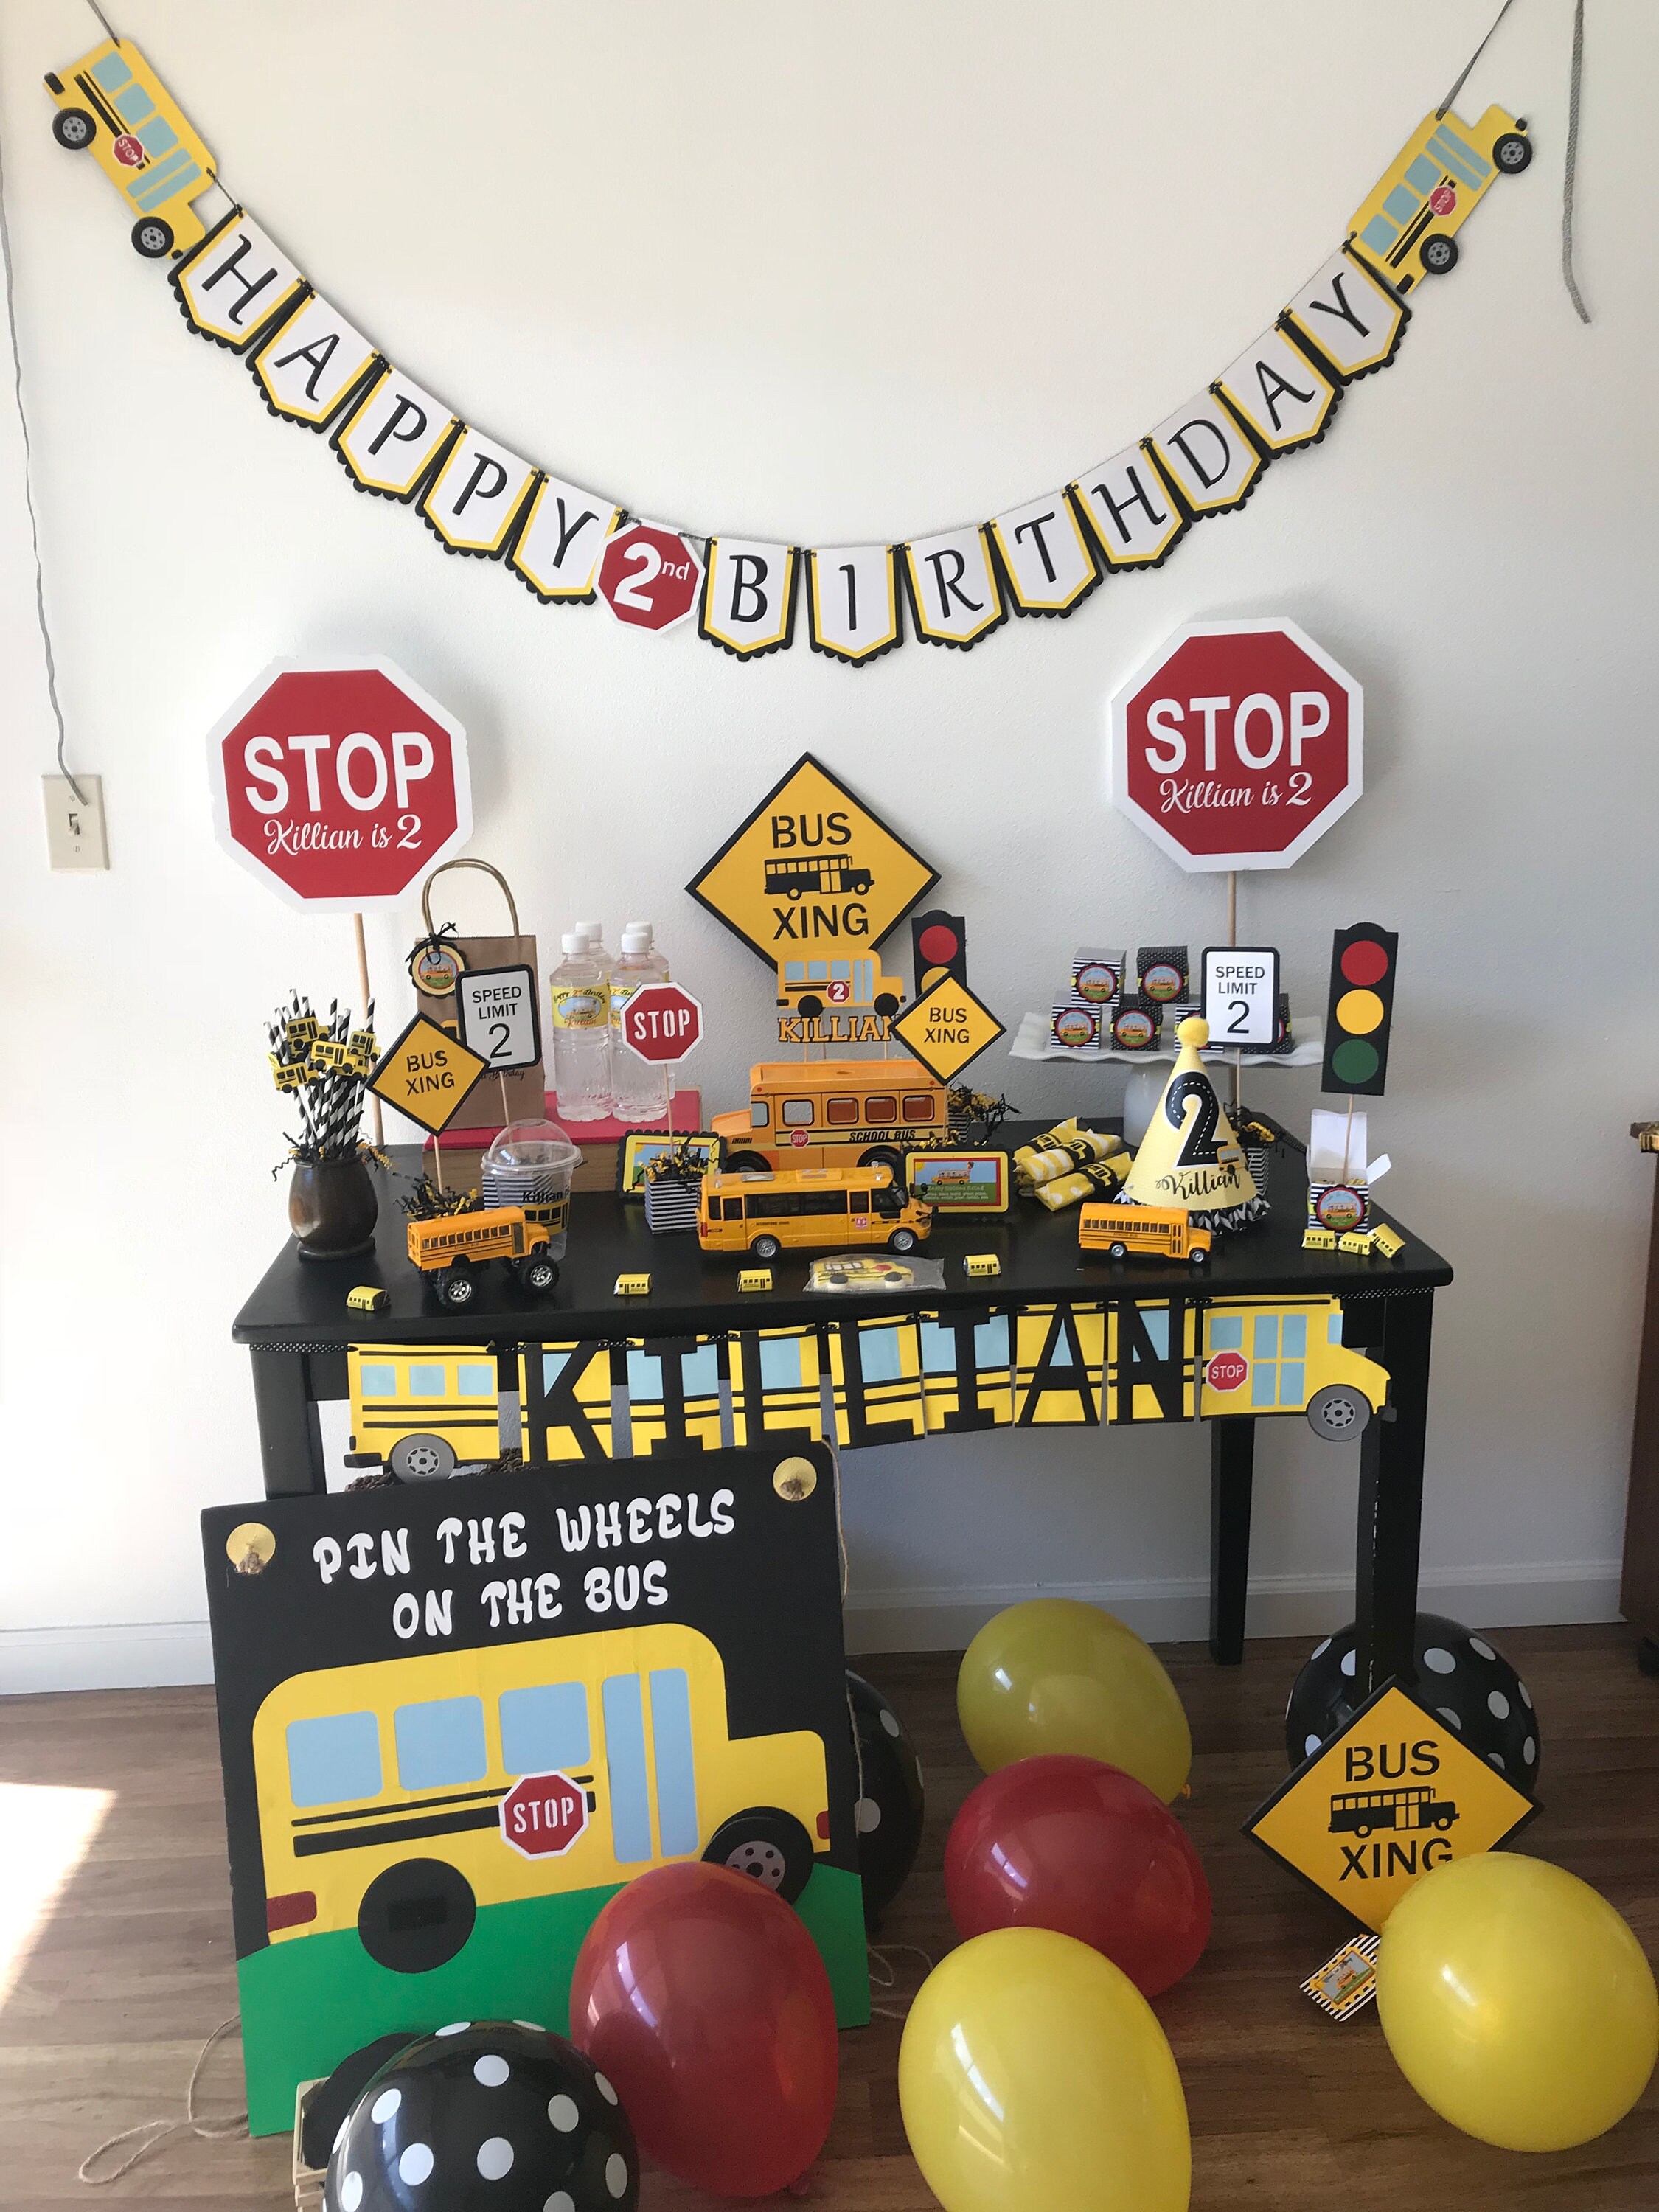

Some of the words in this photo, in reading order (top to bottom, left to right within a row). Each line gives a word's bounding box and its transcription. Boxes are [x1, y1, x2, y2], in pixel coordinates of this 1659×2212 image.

[118, 139, 139, 161] STOP
[201, 234, 599, 568] HAPPY
[613, 541, 688, 613] 2nd
[730, 272, 1370, 631] BIRTHDAY
[1145, 690, 1330, 774] STOP
[244, 731, 434, 815] STOP
[1158, 778, 1255, 814] Killian
[1261, 781, 1283, 807] is
[1286, 772, 1312, 806] 2
[263, 818, 364, 855] Killian
[371, 823, 393, 849] is
[396, 814, 422, 849] 2
[771, 812, 852, 849] BUS
[773, 903, 869, 940] XING
[1215, 966, 1265, 978] SPEED
[472, 986, 522, 1004] SPEED
[832, 983, 845, 1000] 2
[1218, 982, 1258, 995] LIMIT
[479, 1003, 518, 1020] LIMIT
[633, 1009, 690, 1040] STOP
[929, 1007, 967, 1023] BUS
[1227, 1000, 1250, 1034] 2
[488, 1023, 512, 1059] 2
[924, 1028, 970, 1043] XING
[406, 1050, 448, 1072] BUS
[405, 1071, 456, 1096] XING
[1165, 1071, 1228, 1167] 2
[792, 1134, 807, 1143] STOP
[849, 1130, 891, 1142] SCHOOL
[894, 1130, 916, 1141] BUS
[522, 1190, 563, 1204] Killian
[1155, 1170, 1240, 1200] Killian
[521, 1299, 1186, 1466] KILLIAN
[1211, 1364, 1244, 1379] STOP
[313, 1528, 410, 1584] PIN
[437, 1512, 528, 1565] THE
[557, 1489, 736, 1552] WHEELS
[392, 1588, 453, 1639] ON
[481, 1572, 562, 1627] THE
[584, 1559, 670, 1613] BUS
[1345, 1740, 1440, 1782] BUS
[512, 1796, 574, 1834] STOP
[1339, 1837, 1453, 1882] XING
